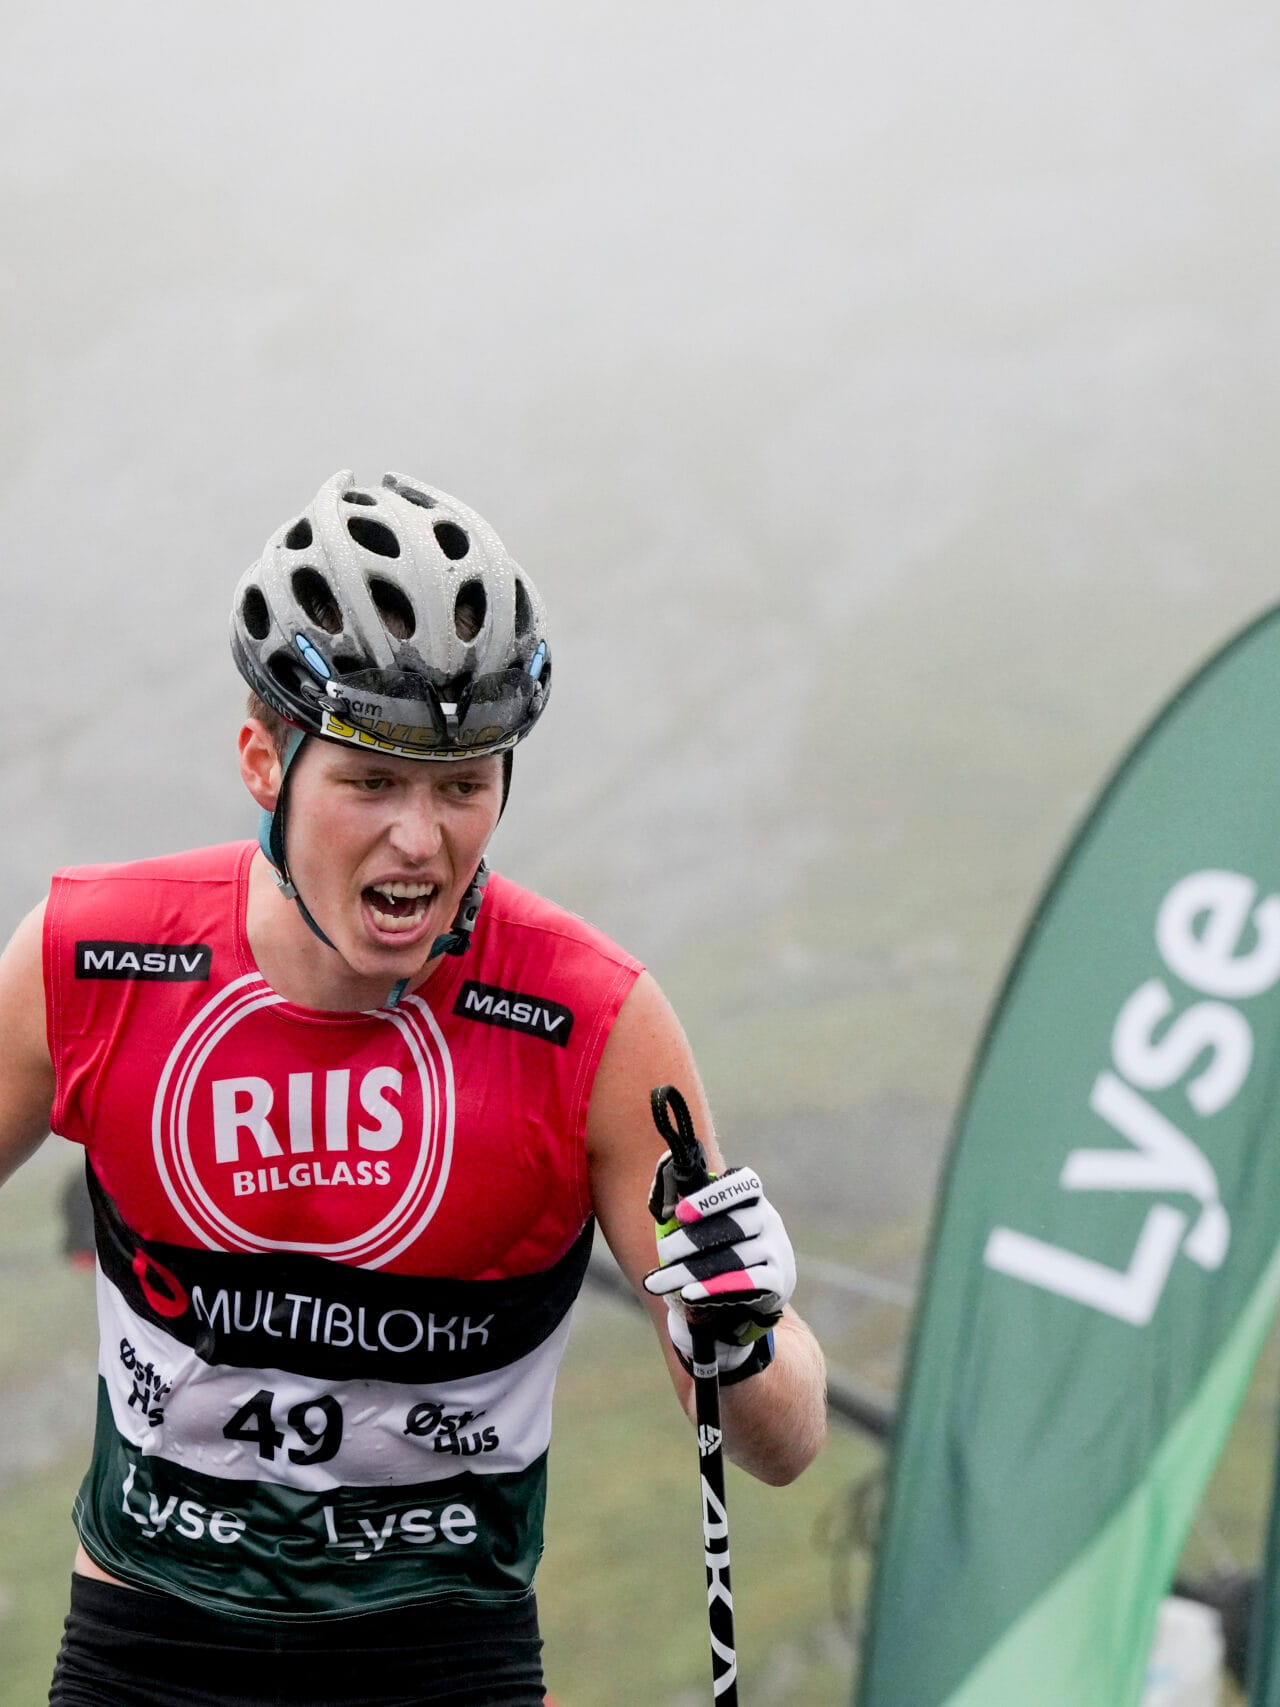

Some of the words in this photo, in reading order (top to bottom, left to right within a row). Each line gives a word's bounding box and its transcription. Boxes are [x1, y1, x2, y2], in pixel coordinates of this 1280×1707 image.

[82, 949, 204, 974] MASIV
[464, 989, 566, 1034] MASIV
[211, 1065, 404, 1165] RIIS
[982, 868, 1280, 1328] Lyse
[232, 1159, 392, 1197] BILGLASS
[698, 1177, 761, 1211] NORTHUG
[192, 1284, 495, 1354] MULTIBLOKK
[222, 1390, 344, 1466] 49
[122, 1462, 246, 1545] Lyse
[321, 1503, 479, 1562] Lyse
